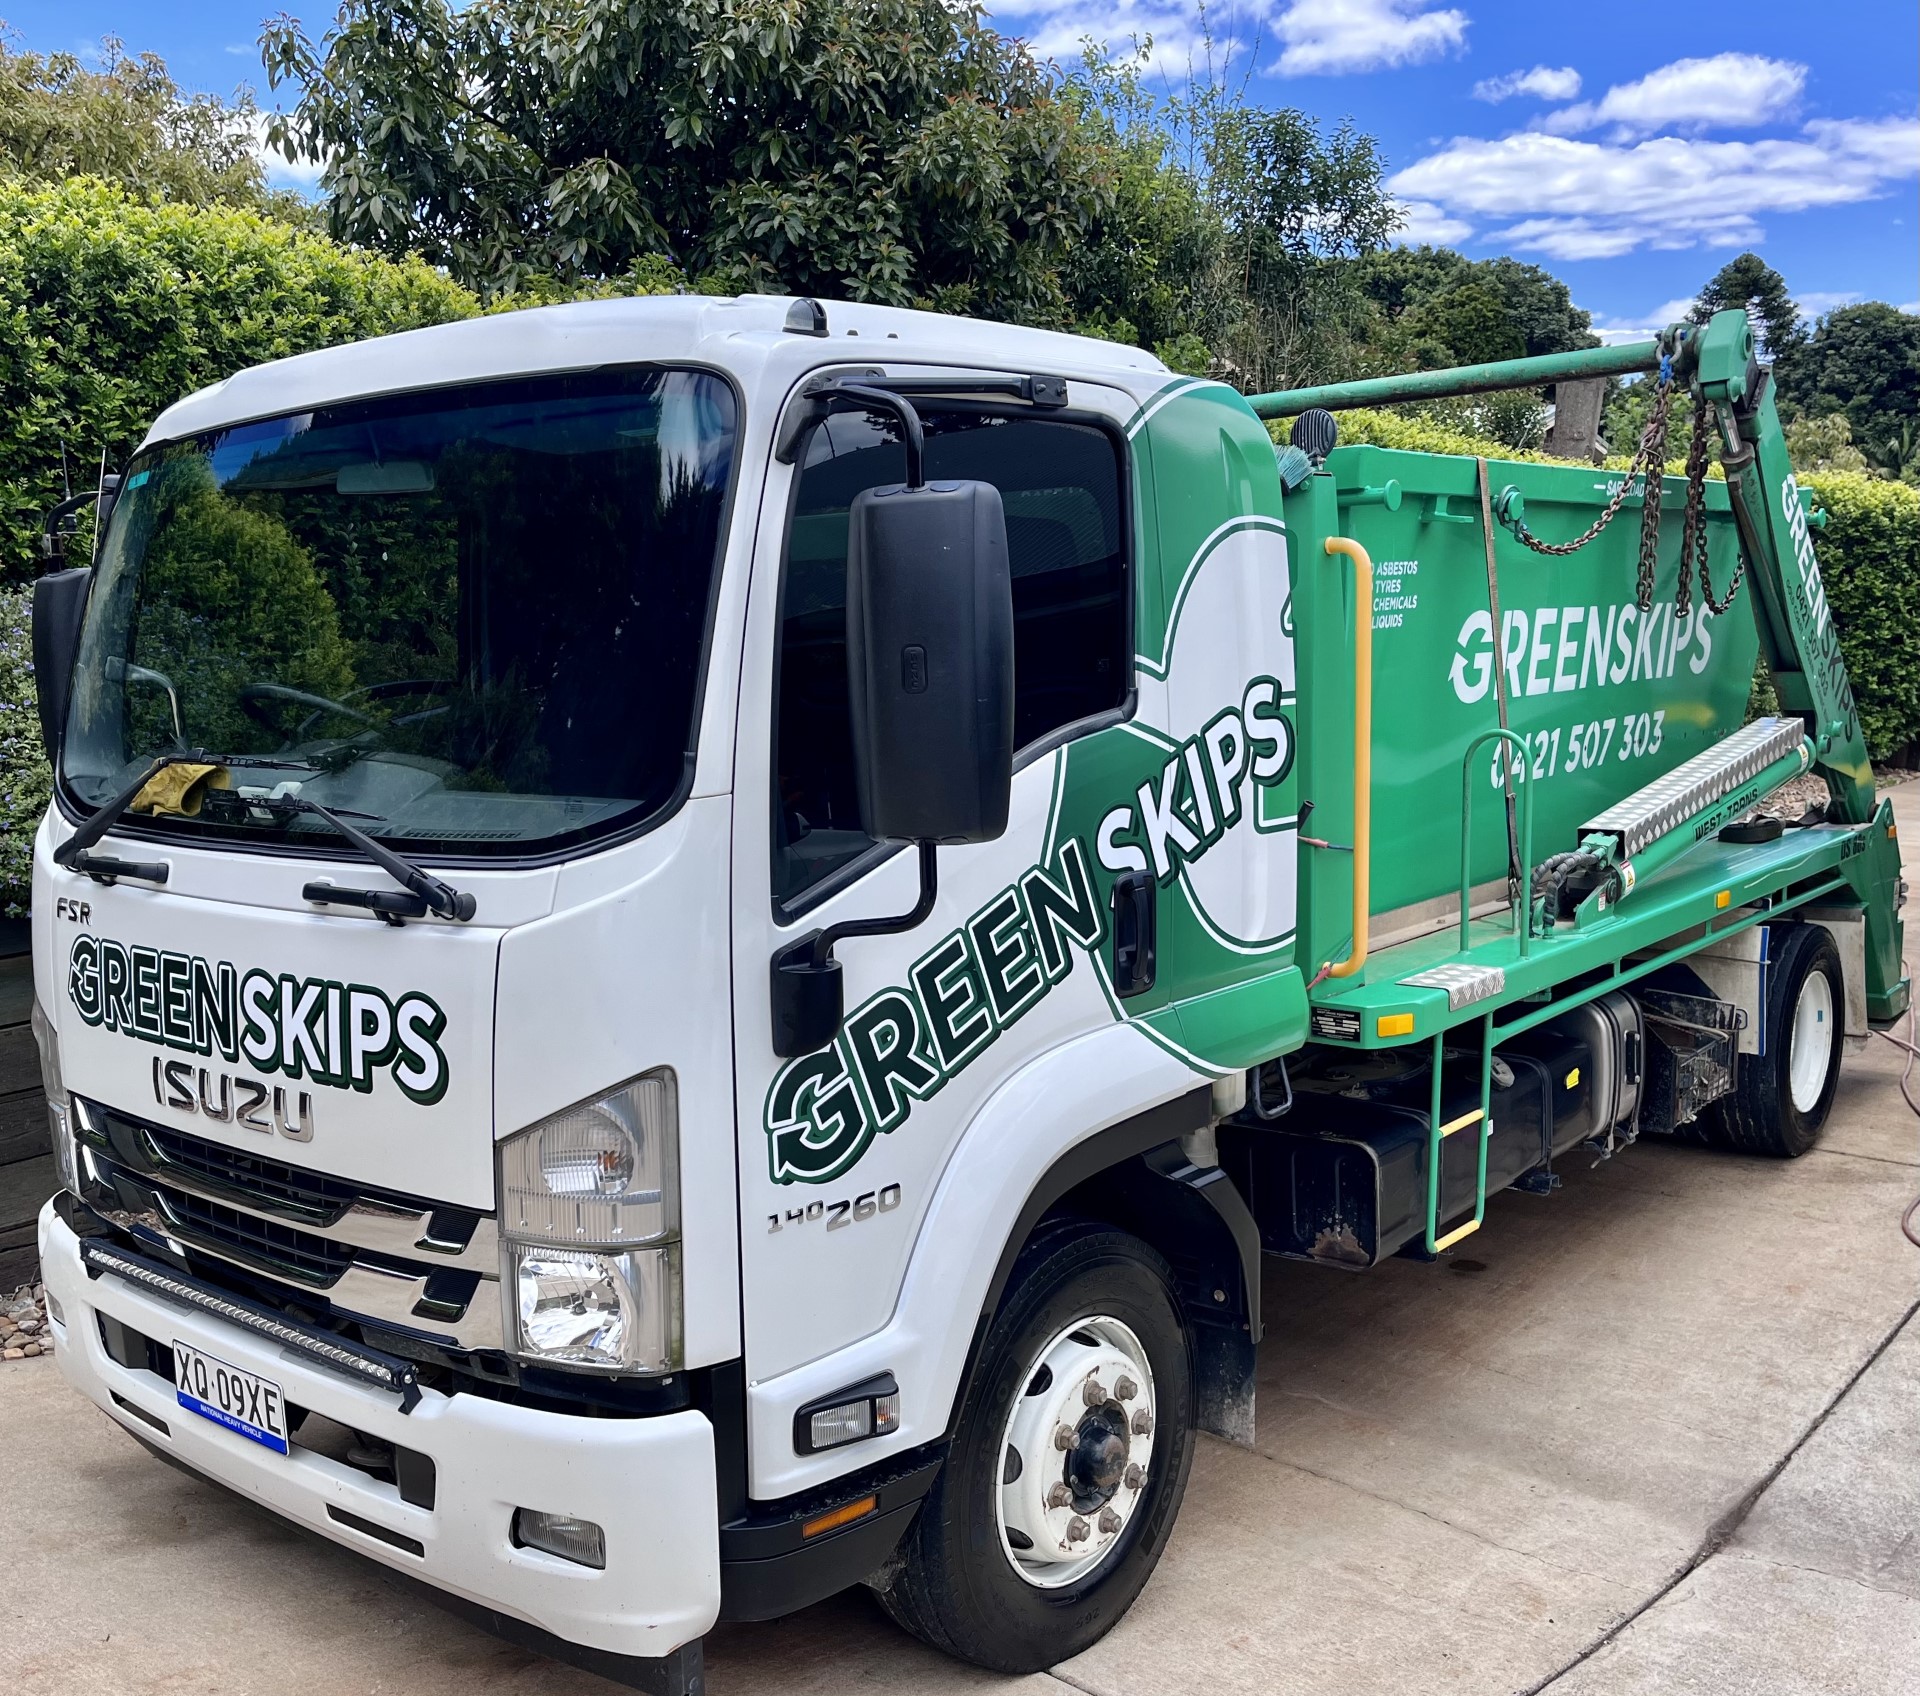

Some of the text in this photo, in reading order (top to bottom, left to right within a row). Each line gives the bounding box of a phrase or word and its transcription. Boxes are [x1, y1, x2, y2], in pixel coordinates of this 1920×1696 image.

[1376, 560, 1418, 576] ASBESTOS
[1375, 579, 1401, 593] TYRES
[1373, 595, 1418, 612] CHEMICALS
[1371, 613, 1403, 630] LIQUIDS
[1448, 602, 1714, 704] GREENSKIPS
[1564, 720, 1616, 769] 507
[1618, 710, 1666, 761] 303
[57, 896, 92, 926] FSR
[152, 1056, 315, 1143] ISUZU
[826, 1182, 901, 1232] 260
[200, 1403, 262, 1440] NATIONAL HEAVY VEHICLE
